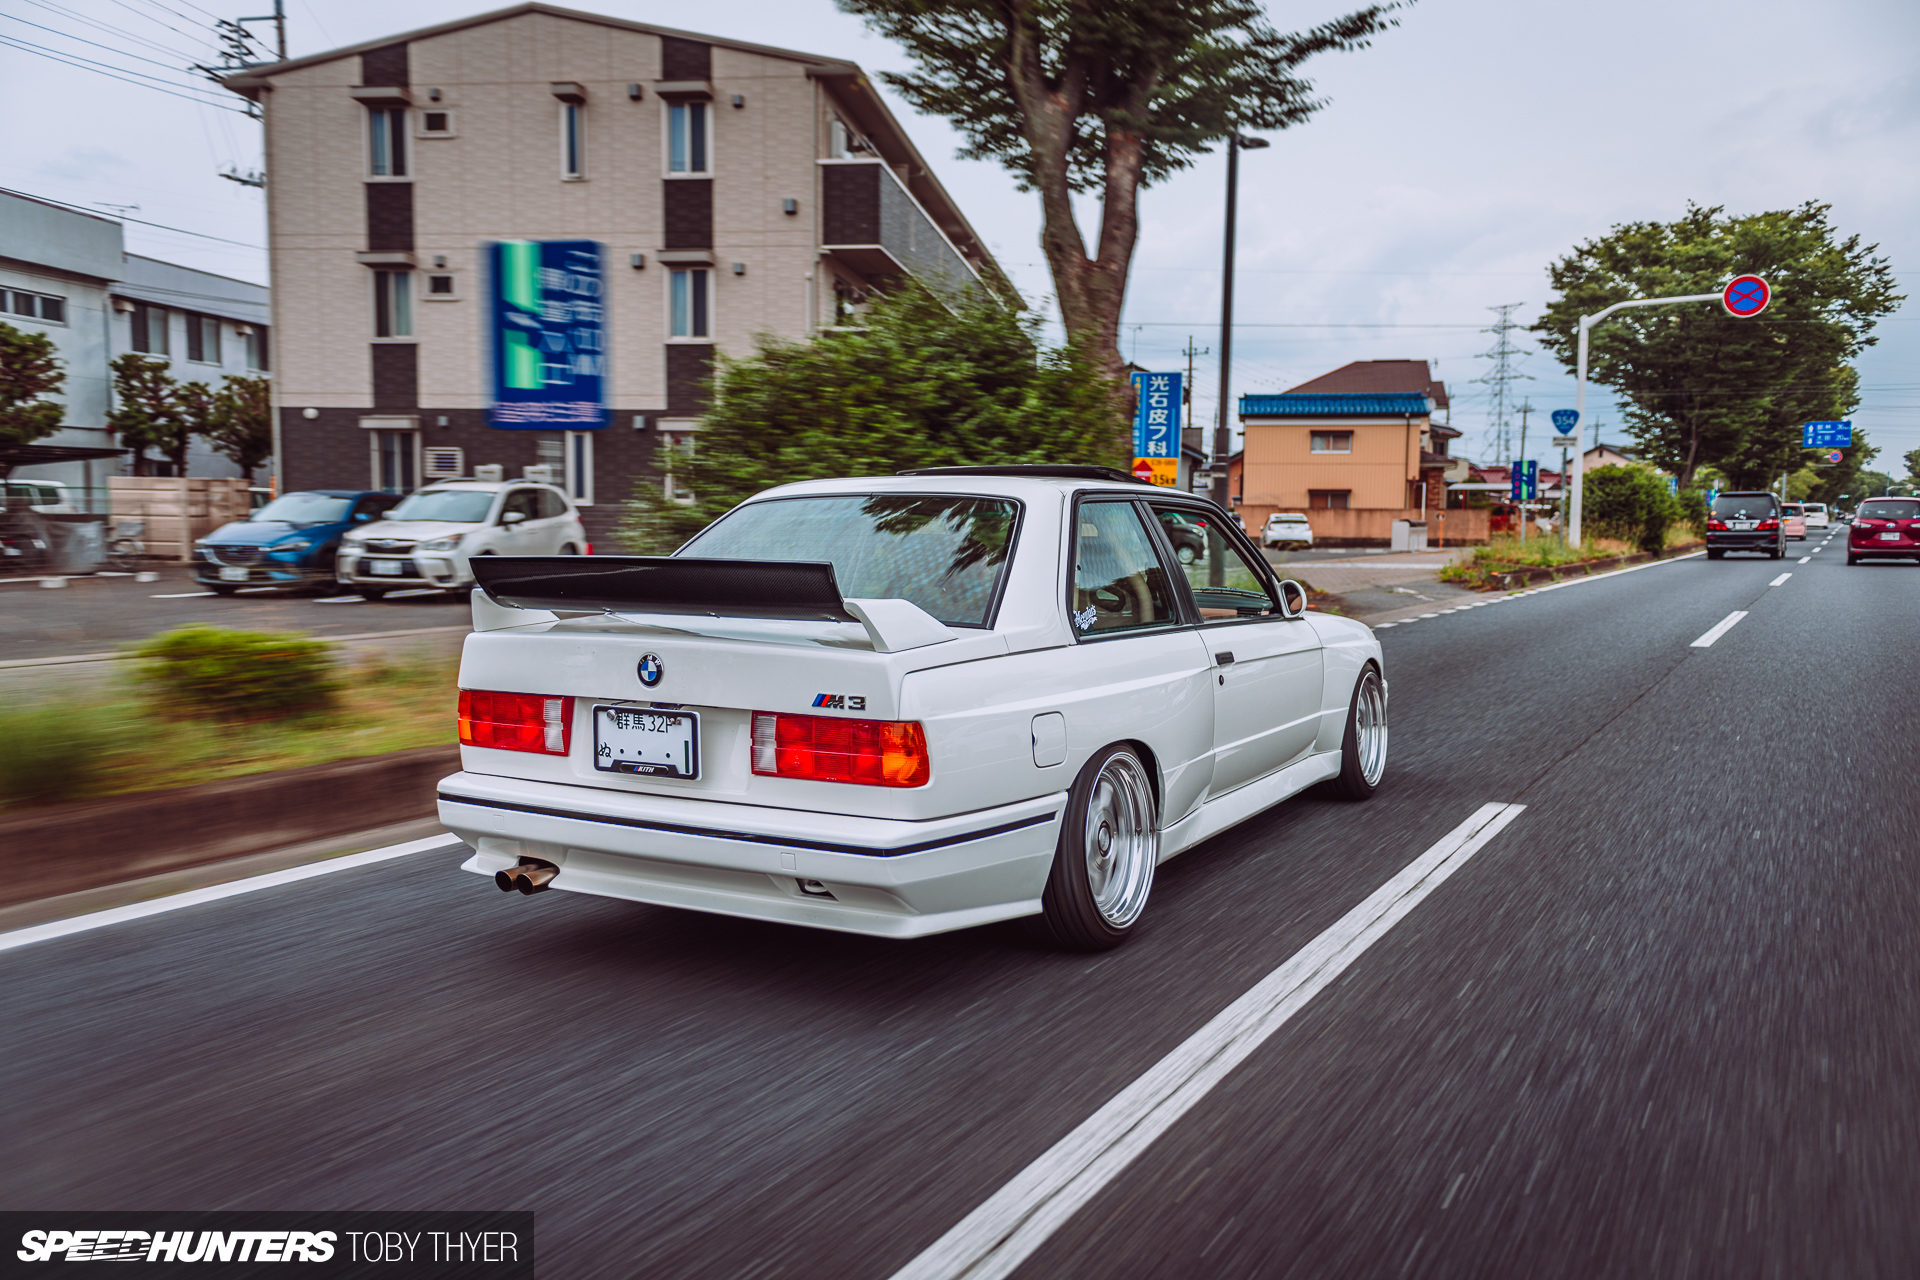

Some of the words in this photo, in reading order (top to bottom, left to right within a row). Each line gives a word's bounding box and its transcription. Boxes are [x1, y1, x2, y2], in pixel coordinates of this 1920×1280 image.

[1147, 375, 1170, 457] 光石皮フ科
[1556, 416, 1575, 425] 354
[598, 742, 612, 758] ぬ
[638, 765, 655, 773] KITH
